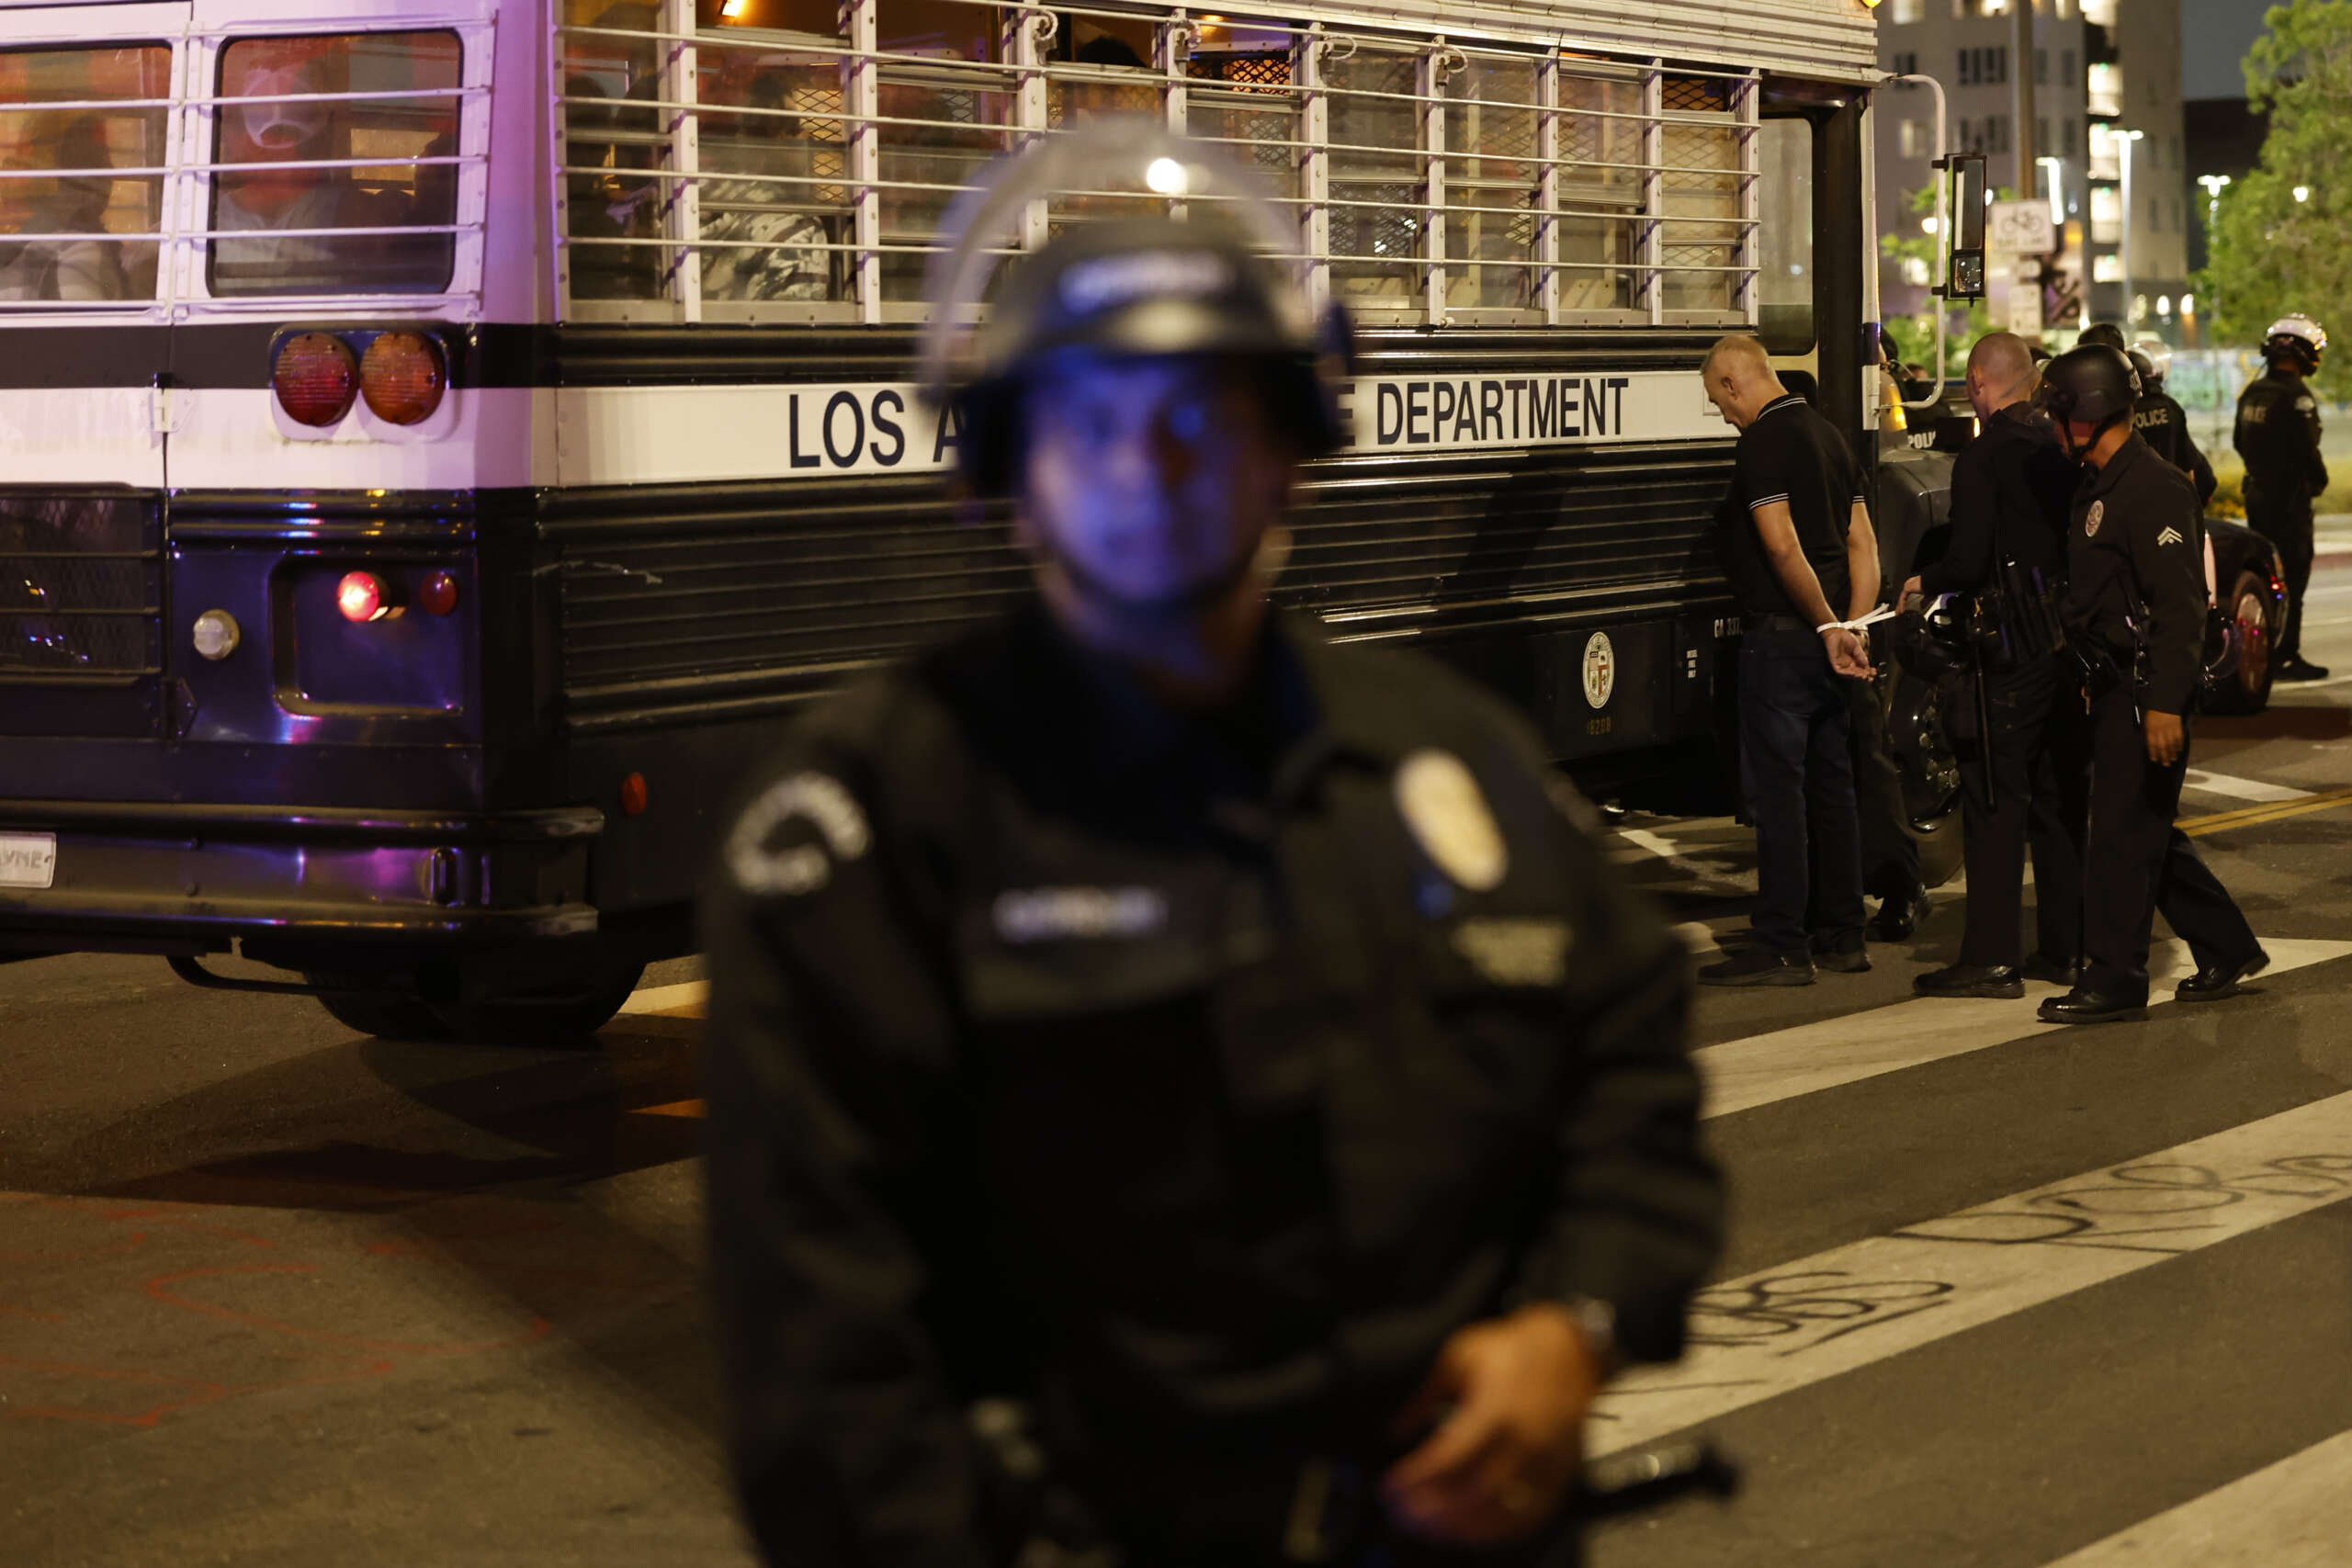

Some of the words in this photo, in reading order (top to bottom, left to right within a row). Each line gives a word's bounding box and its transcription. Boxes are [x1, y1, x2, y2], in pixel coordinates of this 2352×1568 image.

[789, 389, 905, 468] LOS
[1377, 378, 1629, 446] DEPARTMENT
[2132, 408, 2169, 430] POLICE
[1906, 431, 1937, 449] POLI
